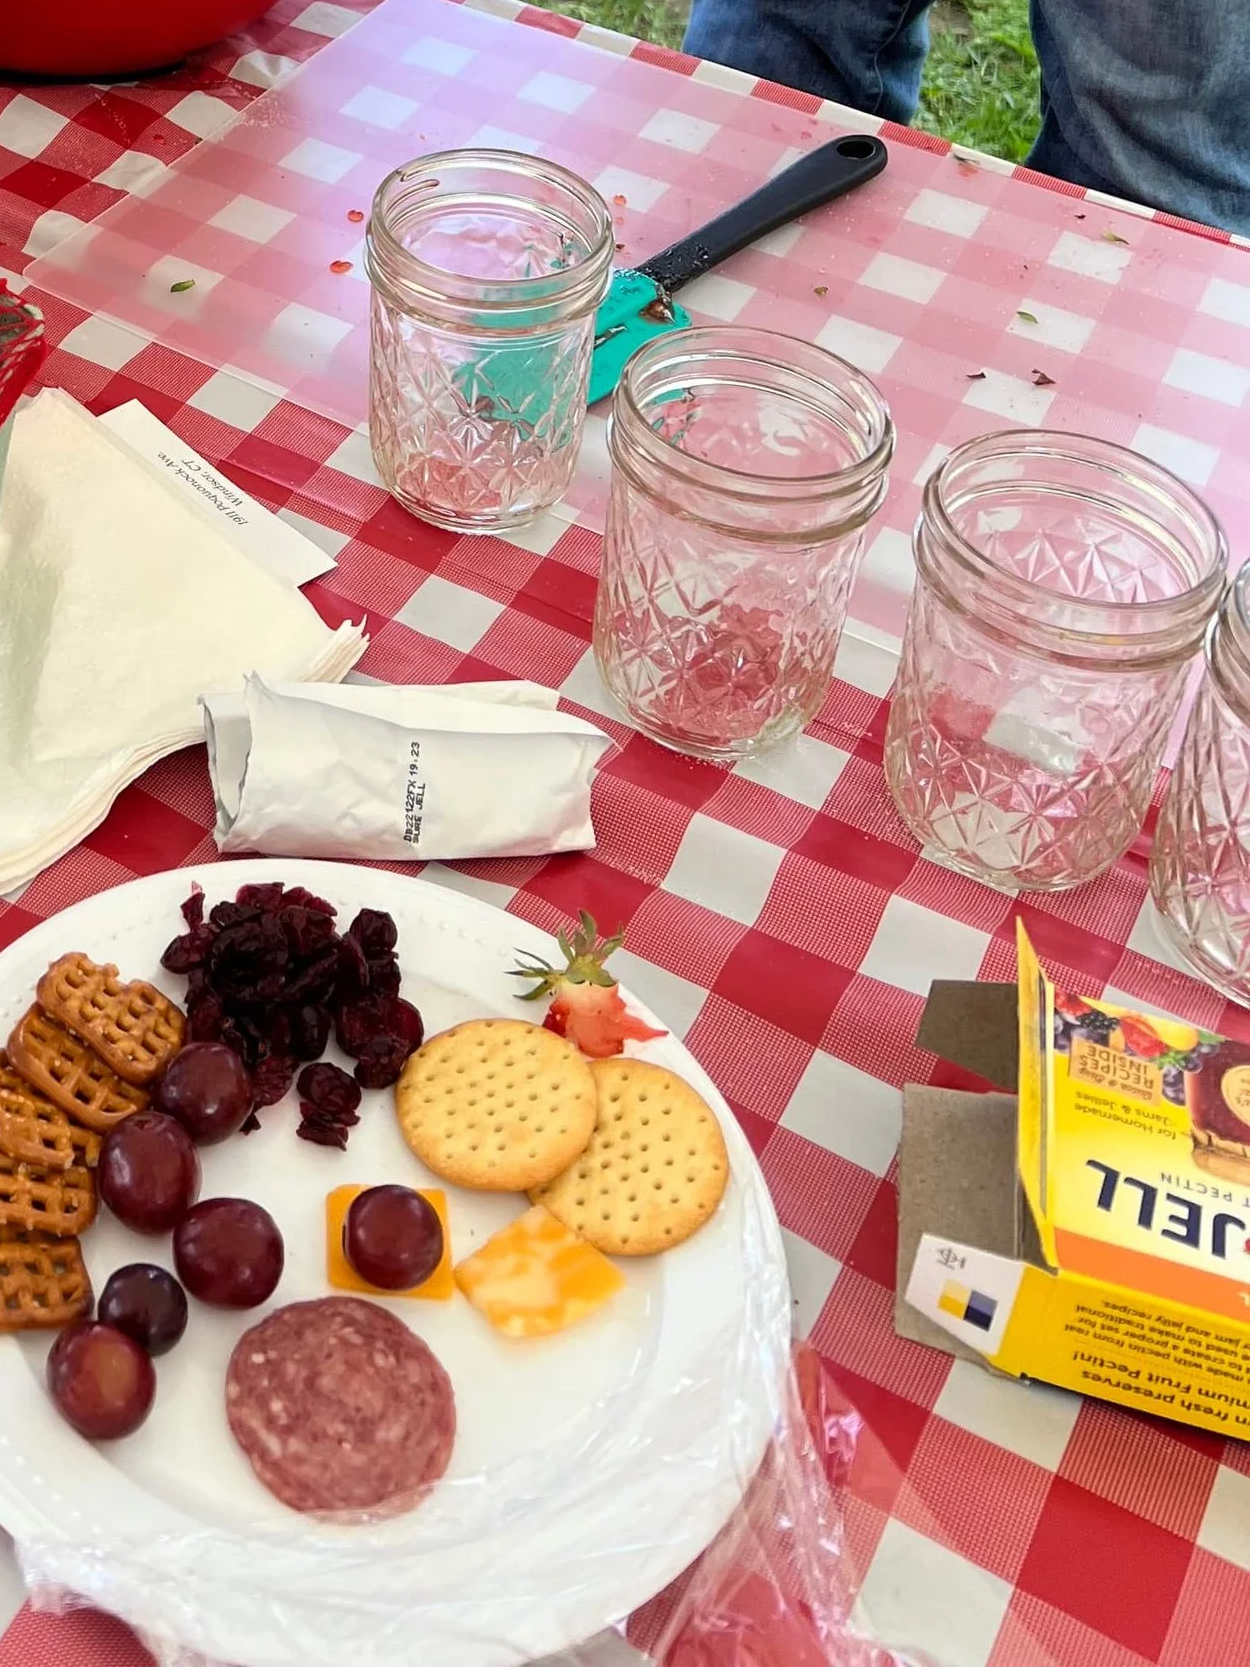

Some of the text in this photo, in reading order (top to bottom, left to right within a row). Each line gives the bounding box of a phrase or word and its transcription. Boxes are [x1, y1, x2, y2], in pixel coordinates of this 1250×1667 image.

[181, 459, 202, 473] CT
[157, 451, 250, 526] 1911 Poquonock Ave
[412, 782, 426, 844] SURE JELL
[1088, 1045, 1148, 1075] INSIDE
[1079, 1054, 1154, 1089] RECIPES
[1075, 1091, 1117, 1110] Jellies
[1075, 1103, 1176, 1140] for Homemade
[1135, 1108, 1171, 1126] Jams
[1160, 1172, 1232, 1202] PECTIN
[1085, 1159, 1246, 1260] JELL
[1076, 1305, 1145, 1330] traditional
[1078, 1318, 1097, 1328] for
[1100, 1323, 1119, 1333] set
[1148, 1325, 1184, 1342] make
[1186, 1325, 1212, 1337] and
[1123, 1331, 1169, 1348] proper
[1188, 1338, 1202, 1348] to
[1215, 1334, 1241, 1348] jam
[1065, 1324, 1244, 1381] made with pectin from real
[1183, 1347, 1225, 1364] create
[1206, 1343, 1238, 1358] used
[1073, 1350, 1141, 1379] Pectin!
[1228, 1361, 1242, 1371] to
[1082, 1370, 1175, 1404] preserves
[1147, 1372, 1191, 1394] Fruit
[1181, 1399, 1229, 1421] fresh
